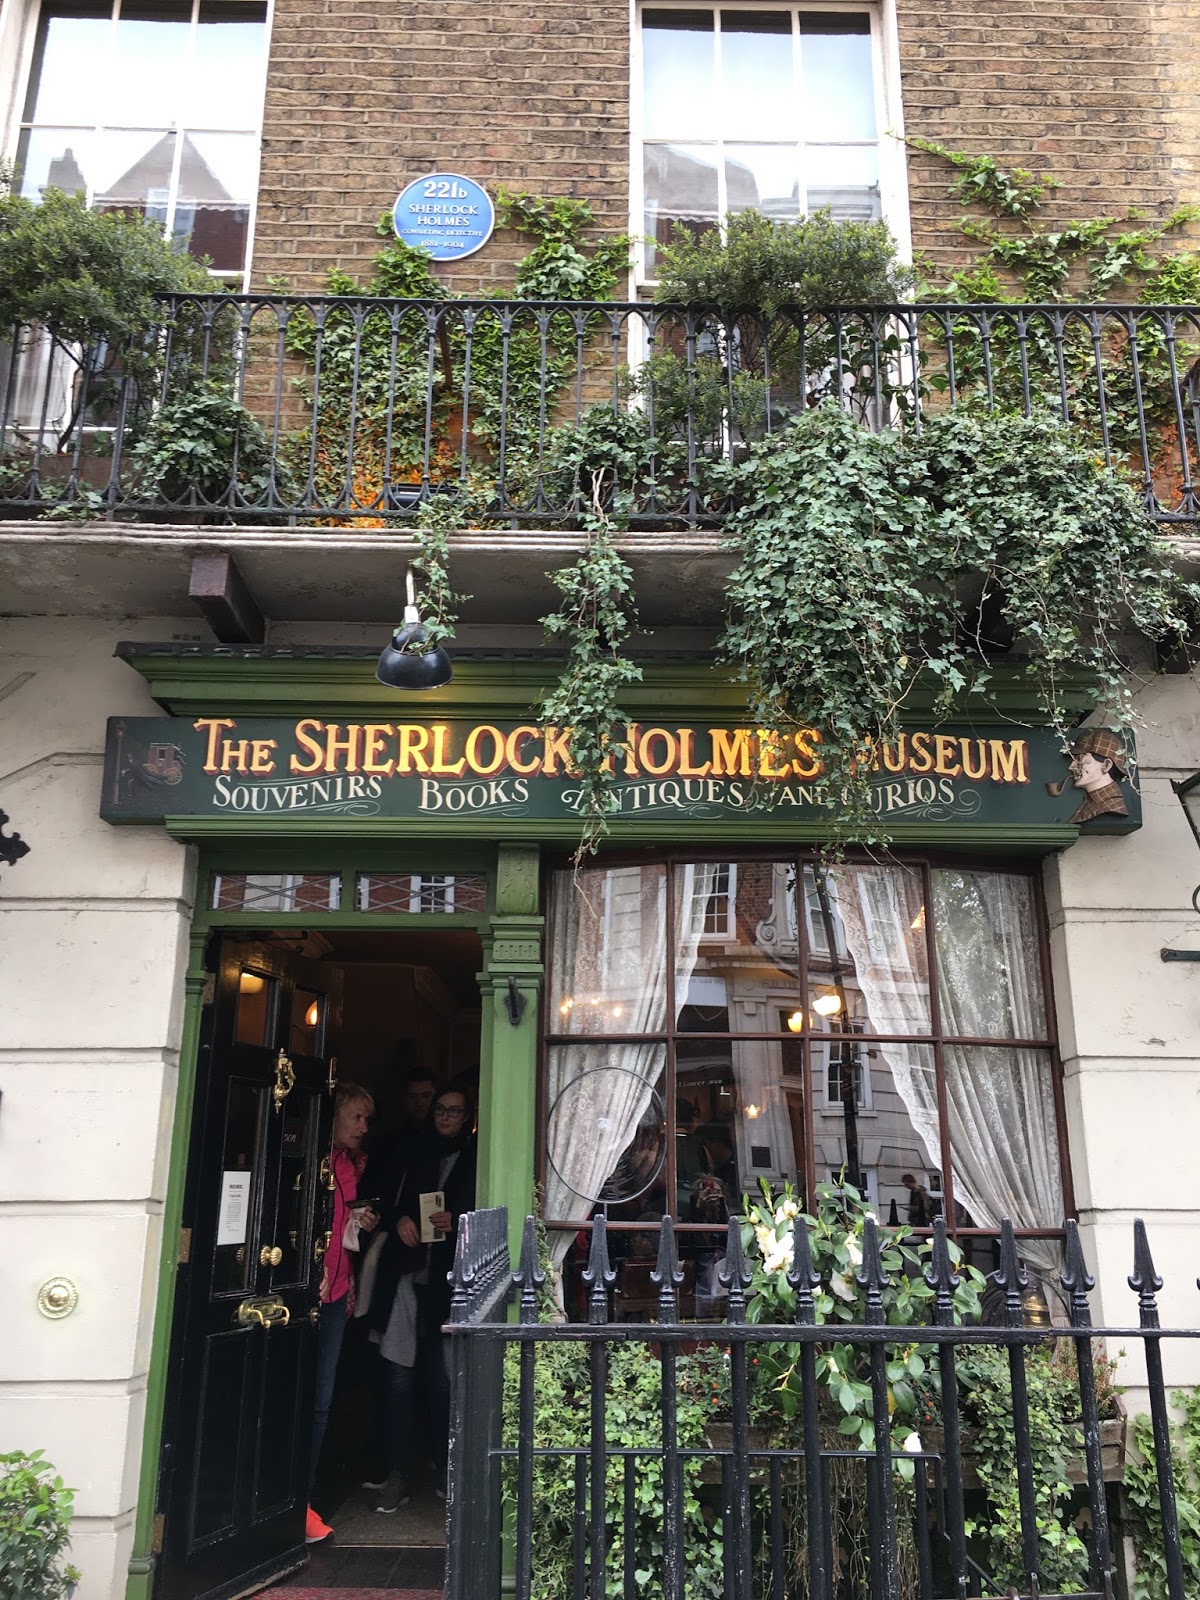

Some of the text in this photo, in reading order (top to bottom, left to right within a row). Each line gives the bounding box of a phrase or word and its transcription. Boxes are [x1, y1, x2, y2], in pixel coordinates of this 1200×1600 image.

[423, 181, 468, 199] 221b
[408, 204, 479, 215] SHERLOCK
[417, 216, 471, 227] HOLMES
[402, 228, 484, 237] CONSULTING DETECTIVE
[290, 718, 585, 779] SHERLOCK
[841, 731, 1031, 785] USEUM
[213, 775, 383, 812] SOUVENIRS
[418, 777, 529, 811] BOOKS
